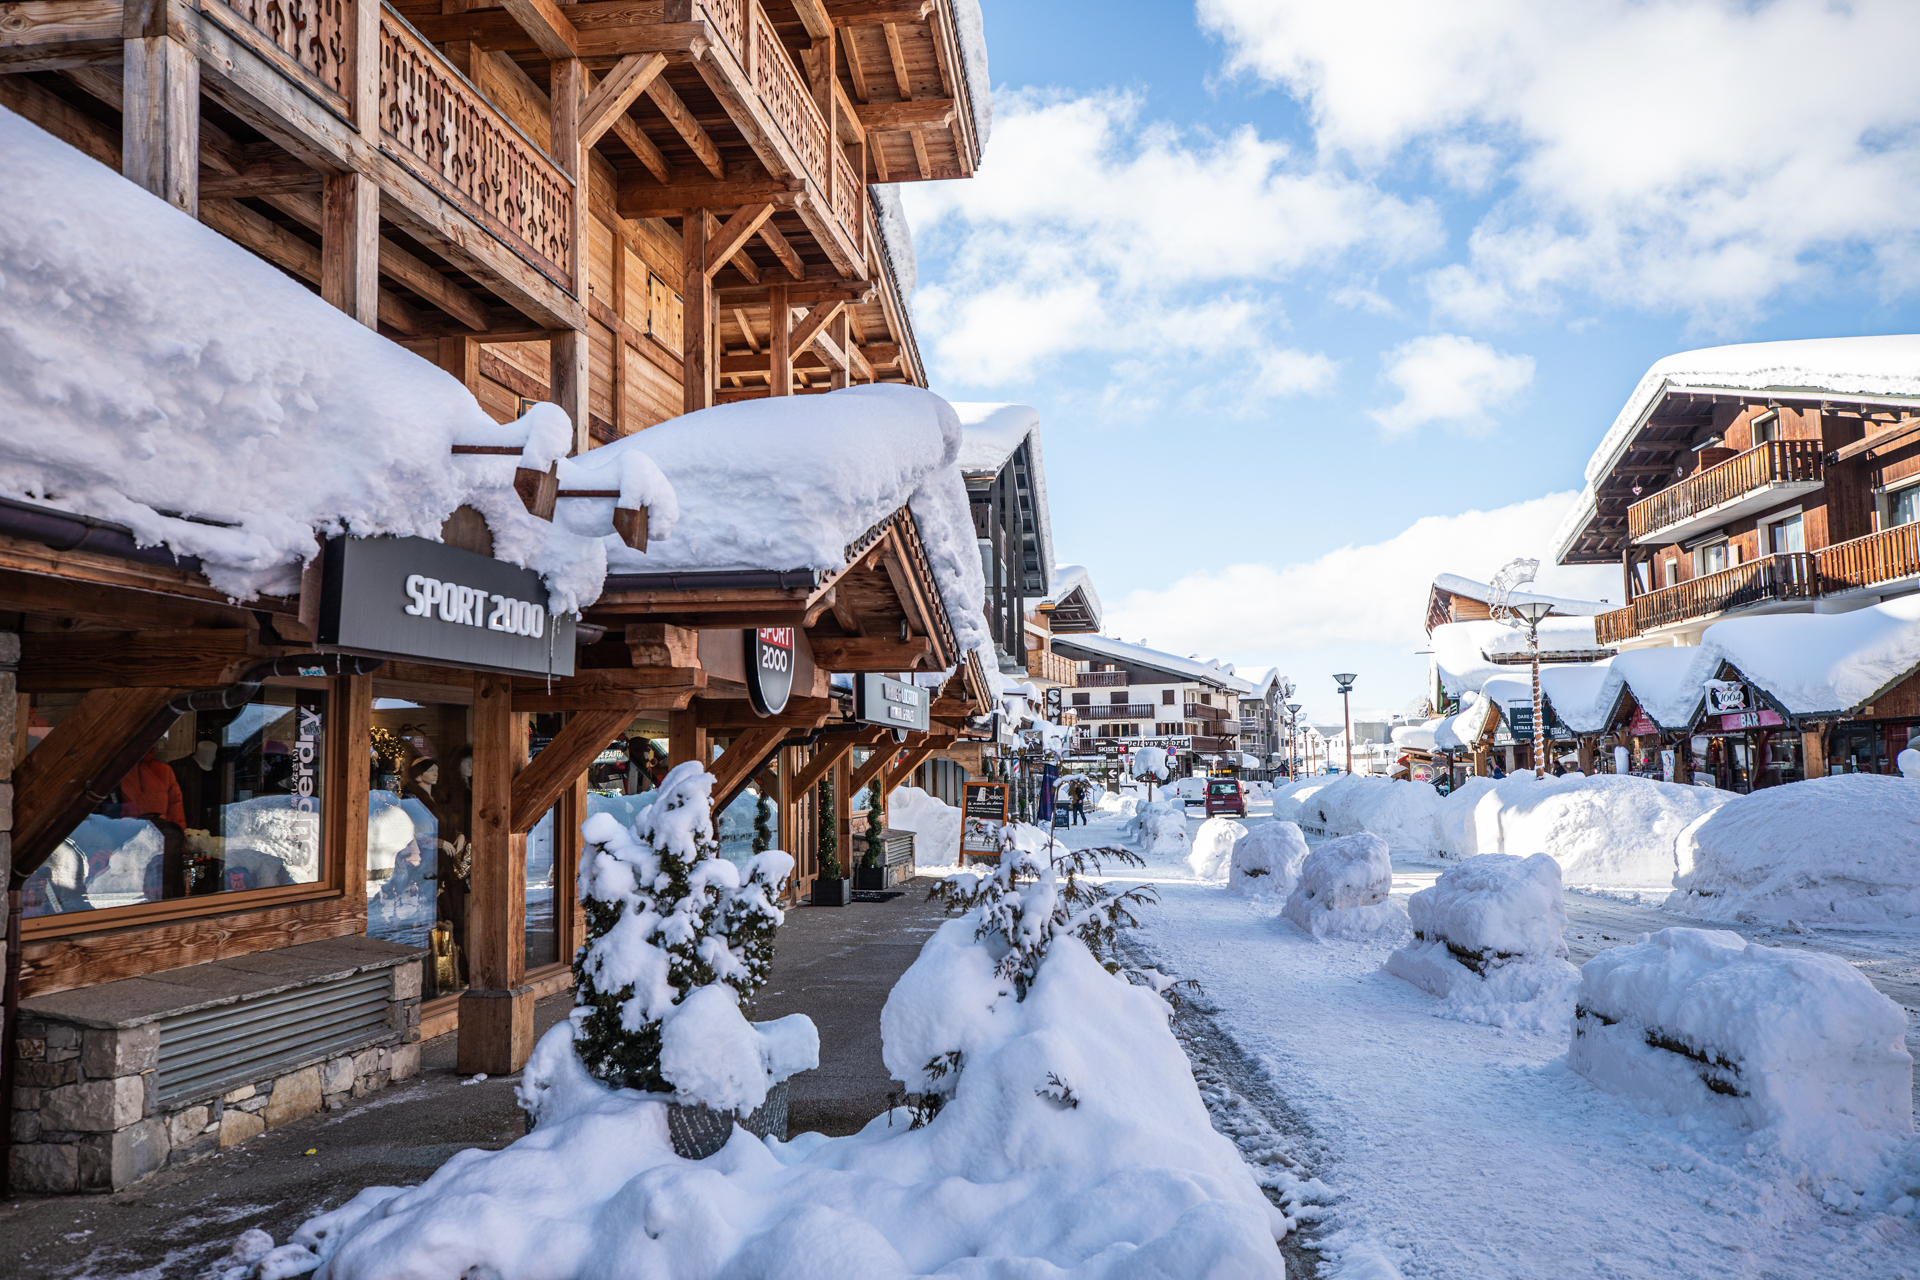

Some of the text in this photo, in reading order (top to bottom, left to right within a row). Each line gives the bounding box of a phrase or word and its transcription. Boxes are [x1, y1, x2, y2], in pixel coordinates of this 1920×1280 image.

[404, 574, 545, 639] SPORT 2000
[760, 628, 791, 646] SPORT
[762, 644, 788, 673] 2000
[1720, 692, 1742, 703] 1664
[1740, 712, 1760, 728] BAR
